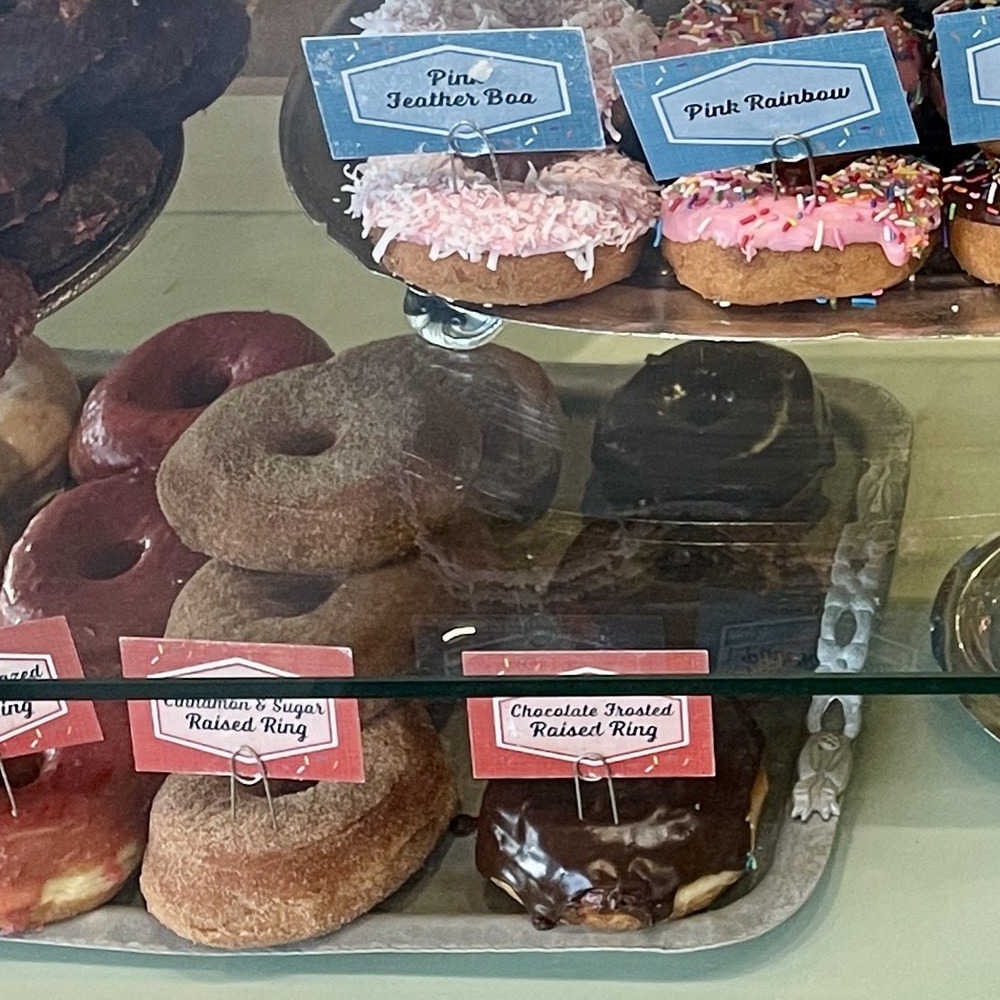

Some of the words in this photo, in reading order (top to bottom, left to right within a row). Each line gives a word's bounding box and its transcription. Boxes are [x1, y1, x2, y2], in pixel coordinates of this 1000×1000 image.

[386, 91, 480, 109] Feather
[483, 88, 538, 105] Boa
[684, 102, 739, 122] Pink
[746, 85, 851, 111] Rainbow
[273, 699, 324, 719] Sugar
[510, 702, 598, 718] Chocolate
[604, 702, 673, 717] Frosted
[186, 713, 256, 732] Raised
[260, 717, 307, 742] Ring
[531, 721, 604, 738] Raised
[609, 721, 658, 743] Ring
